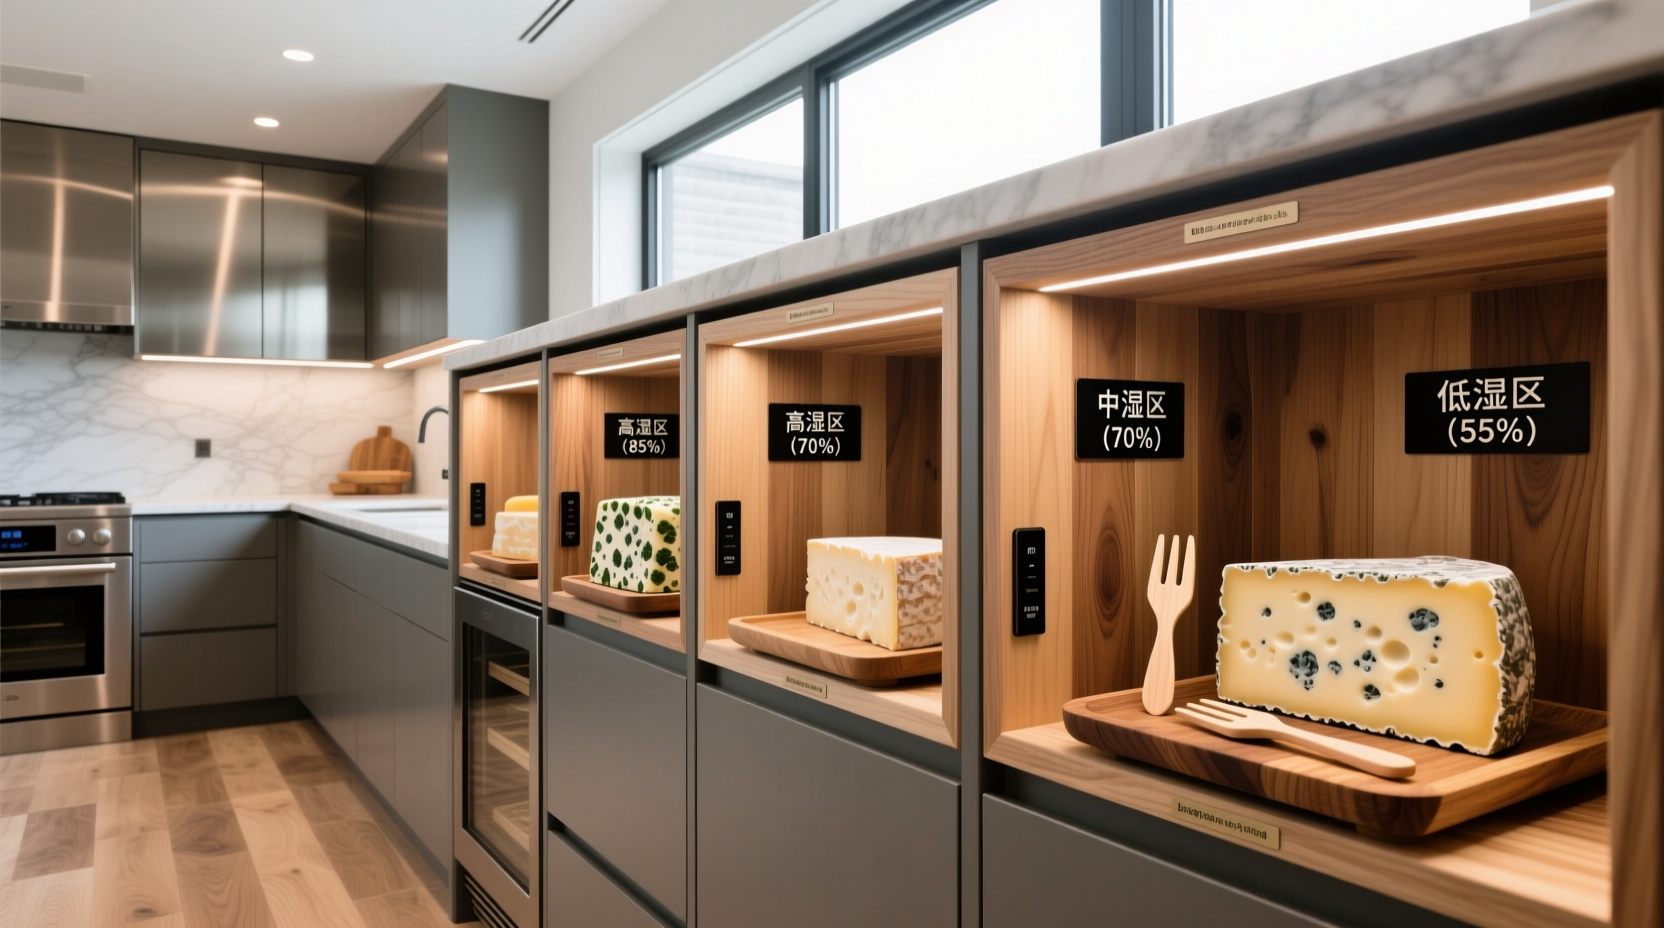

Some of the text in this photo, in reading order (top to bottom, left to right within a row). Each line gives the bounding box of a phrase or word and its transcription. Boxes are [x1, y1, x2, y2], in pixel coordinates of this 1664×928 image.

[1098, 389, 1167, 419] 中湿区
[1437, 376, 1546, 413] 低湿区
[786, 410, 845, 434] 高湿区
[1448, 415, 1536, 448] (55%)
[622, 438, 666, 455] (85%)
[791, 437, 841, 456] (70%)
[1103, 425, 1161, 452] (70%)
